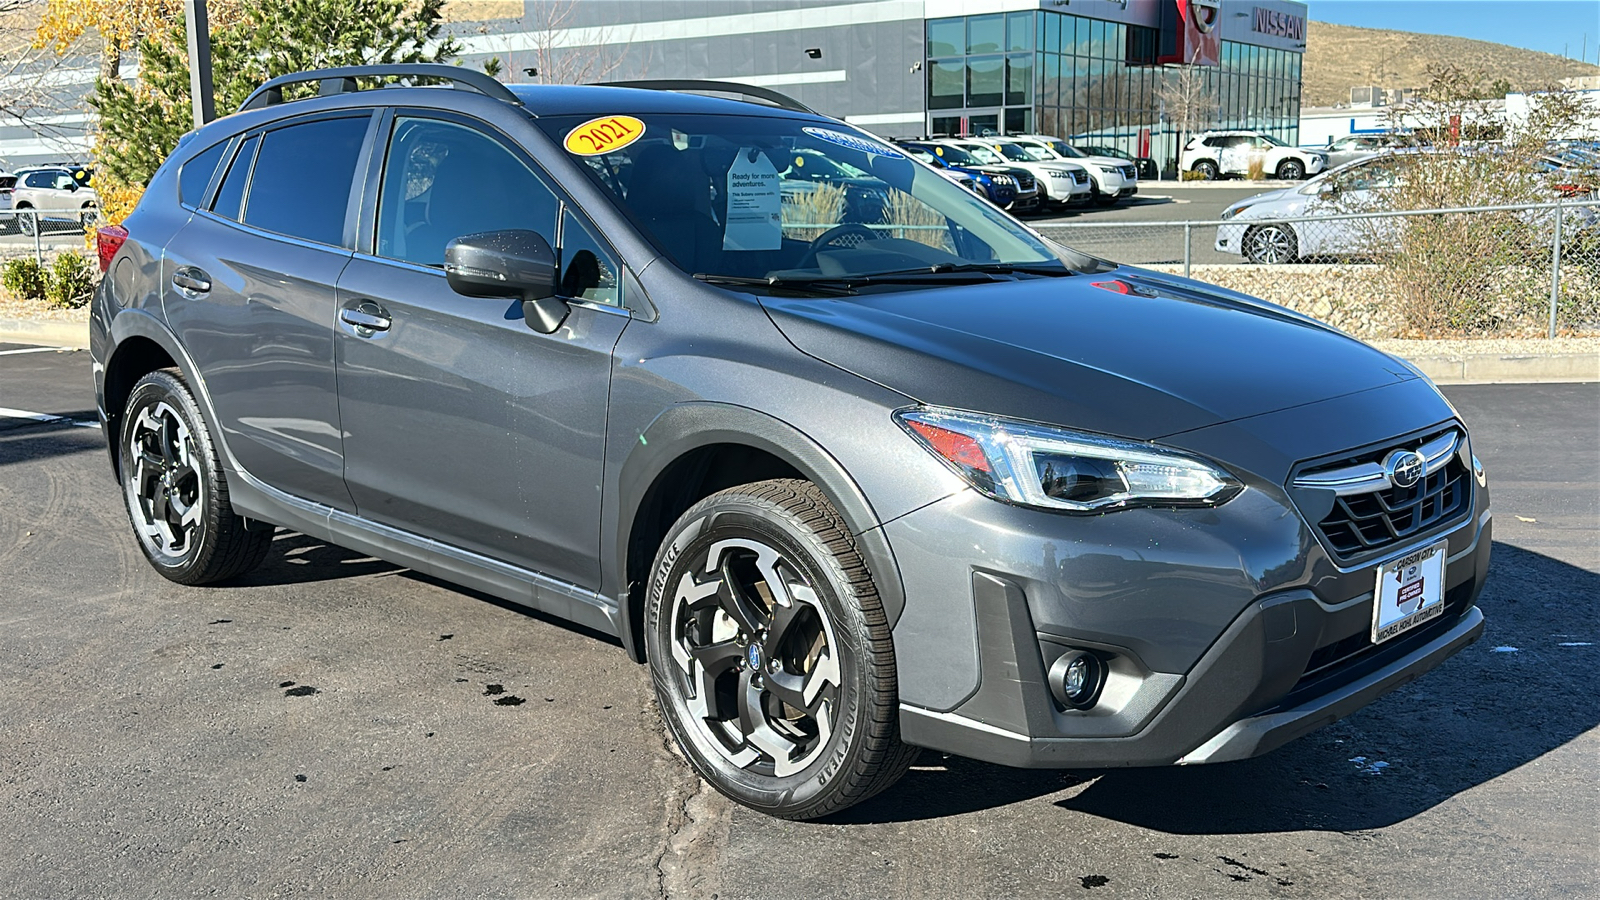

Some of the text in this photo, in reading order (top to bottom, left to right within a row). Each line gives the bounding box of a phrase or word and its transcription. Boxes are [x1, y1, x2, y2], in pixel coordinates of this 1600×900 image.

[1254, 7, 1304, 40] NISSAN
[579, 118, 634, 151] 2021
[1397, 546, 1435, 570] CARSON CITY
[649, 542, 681, 633] ASSURANCE
[1402, 582, 1420, 595] CERTIFIED
[1377, 603, 1443, 641] MICHAEL HOHL AUTOMOTIVE
[817, 686, 858, 787] GOODYEAR
